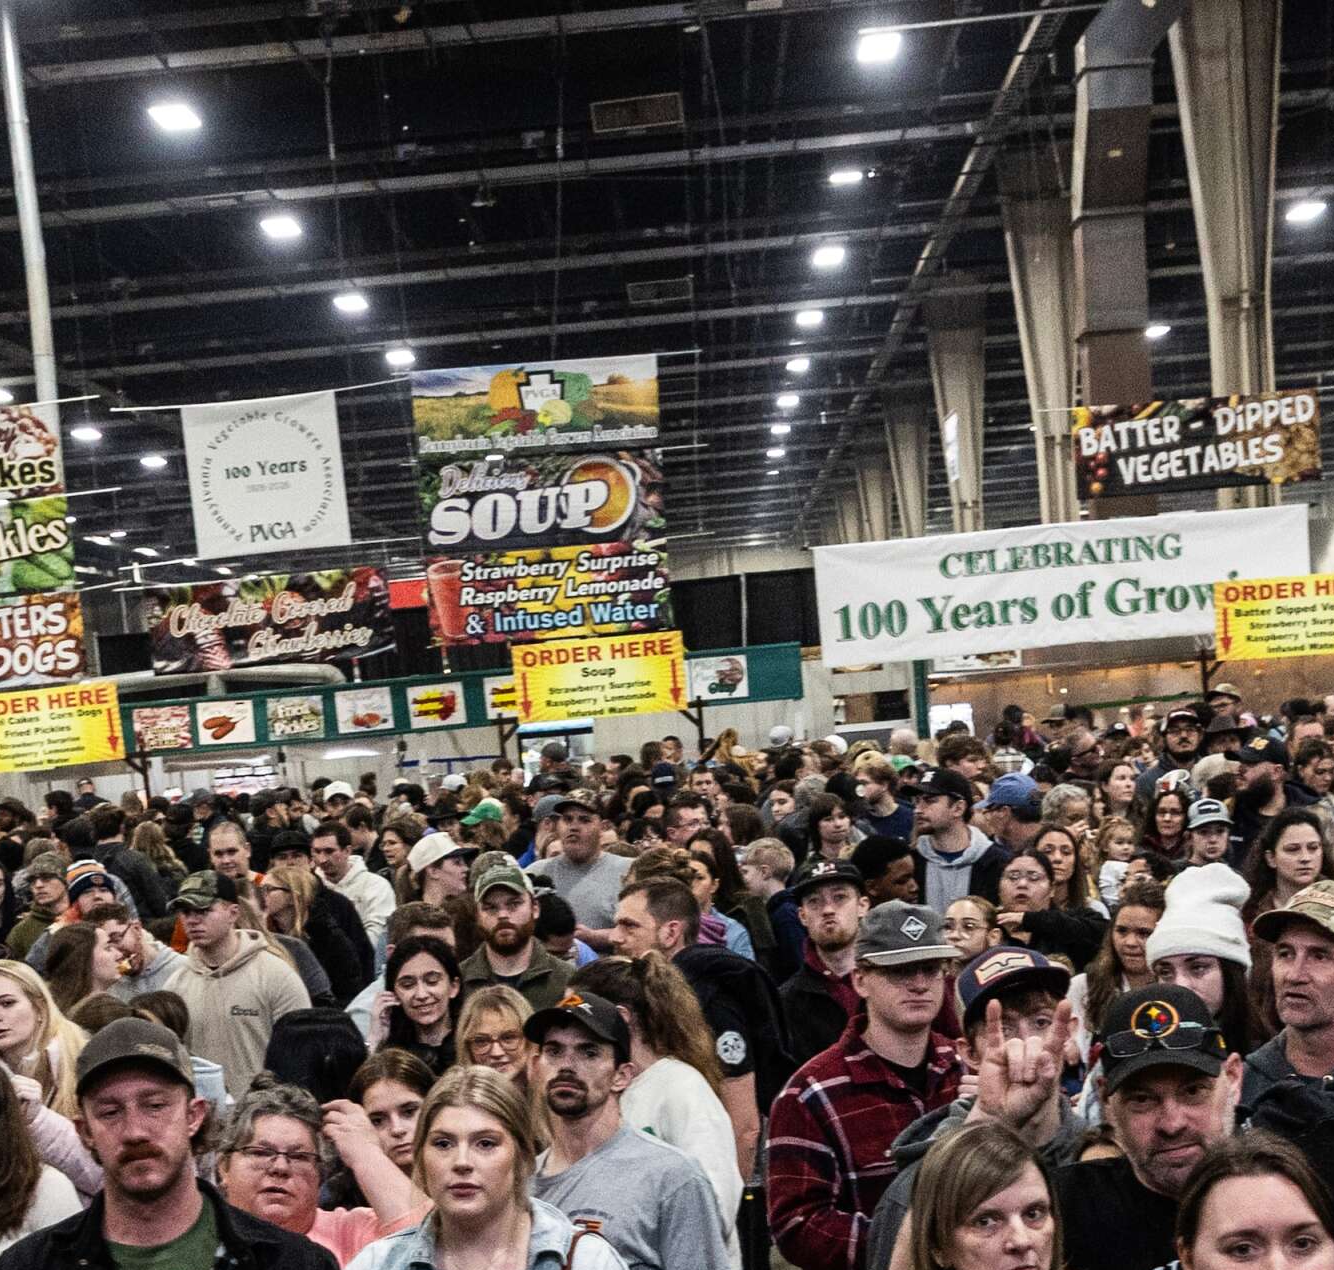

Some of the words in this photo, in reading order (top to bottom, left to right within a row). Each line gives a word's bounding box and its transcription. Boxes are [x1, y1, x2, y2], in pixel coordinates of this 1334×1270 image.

[1079, 415, 1180, 456] BATTER
[225, 466, 251, 479] 100
[256, 460, 307, 475] Years
[1118, 434, 1284, 485] VEGETABLES
[428, 480, 608, 546] SOUP
[461, 559, 567, 581] Strawberry
[577, 550, 659, 574] Surprise
[939, 534, 1182, 579] CELEBRATING
[460, 585, 557, 608] Raspberry
[567, 571, 664, 597] Lemonade
[1224, 582, 1306, 603] ORDER
[170, 602, 265, 637] Chocolate
[272, 581, 356, 623] Covered
[467, 615, 485, 634] &
[495, 604, 583, 631] Infused
[590, 602, 659, 624] Water
[834, 599, 907, 642] 100
[917, 594, 1038, 635] Years
[1051, 581, 1096, 620] of
[1105, 571, 1238, 617] Grow
[1235, 607, 1271, 617] Batter
[1276, 604, 1316, 616] Dipped
[1246, 632, 1298, 643] Raspberry
[1249, 620, 1306, 630] Strawberry
[247, 621, 373, 660] Strawberries
[522, 645, 601, 667] ORDER
[611, 638, 673, 660] HERE
[581, 667, 616, 678] Soup
[47, 688, 109, 709] HERE
[549, 684, 605, 695] Strawberry
[610, 679, 651, 690] Surprise
[545, 696, 597, 707] Raspberry
[8, 716, 40, 725] Cakes
[77, 708, 103, 718] Dogs
[4, 728, 30, 738] Fried
[35, 725, 71, 735] Pickles
